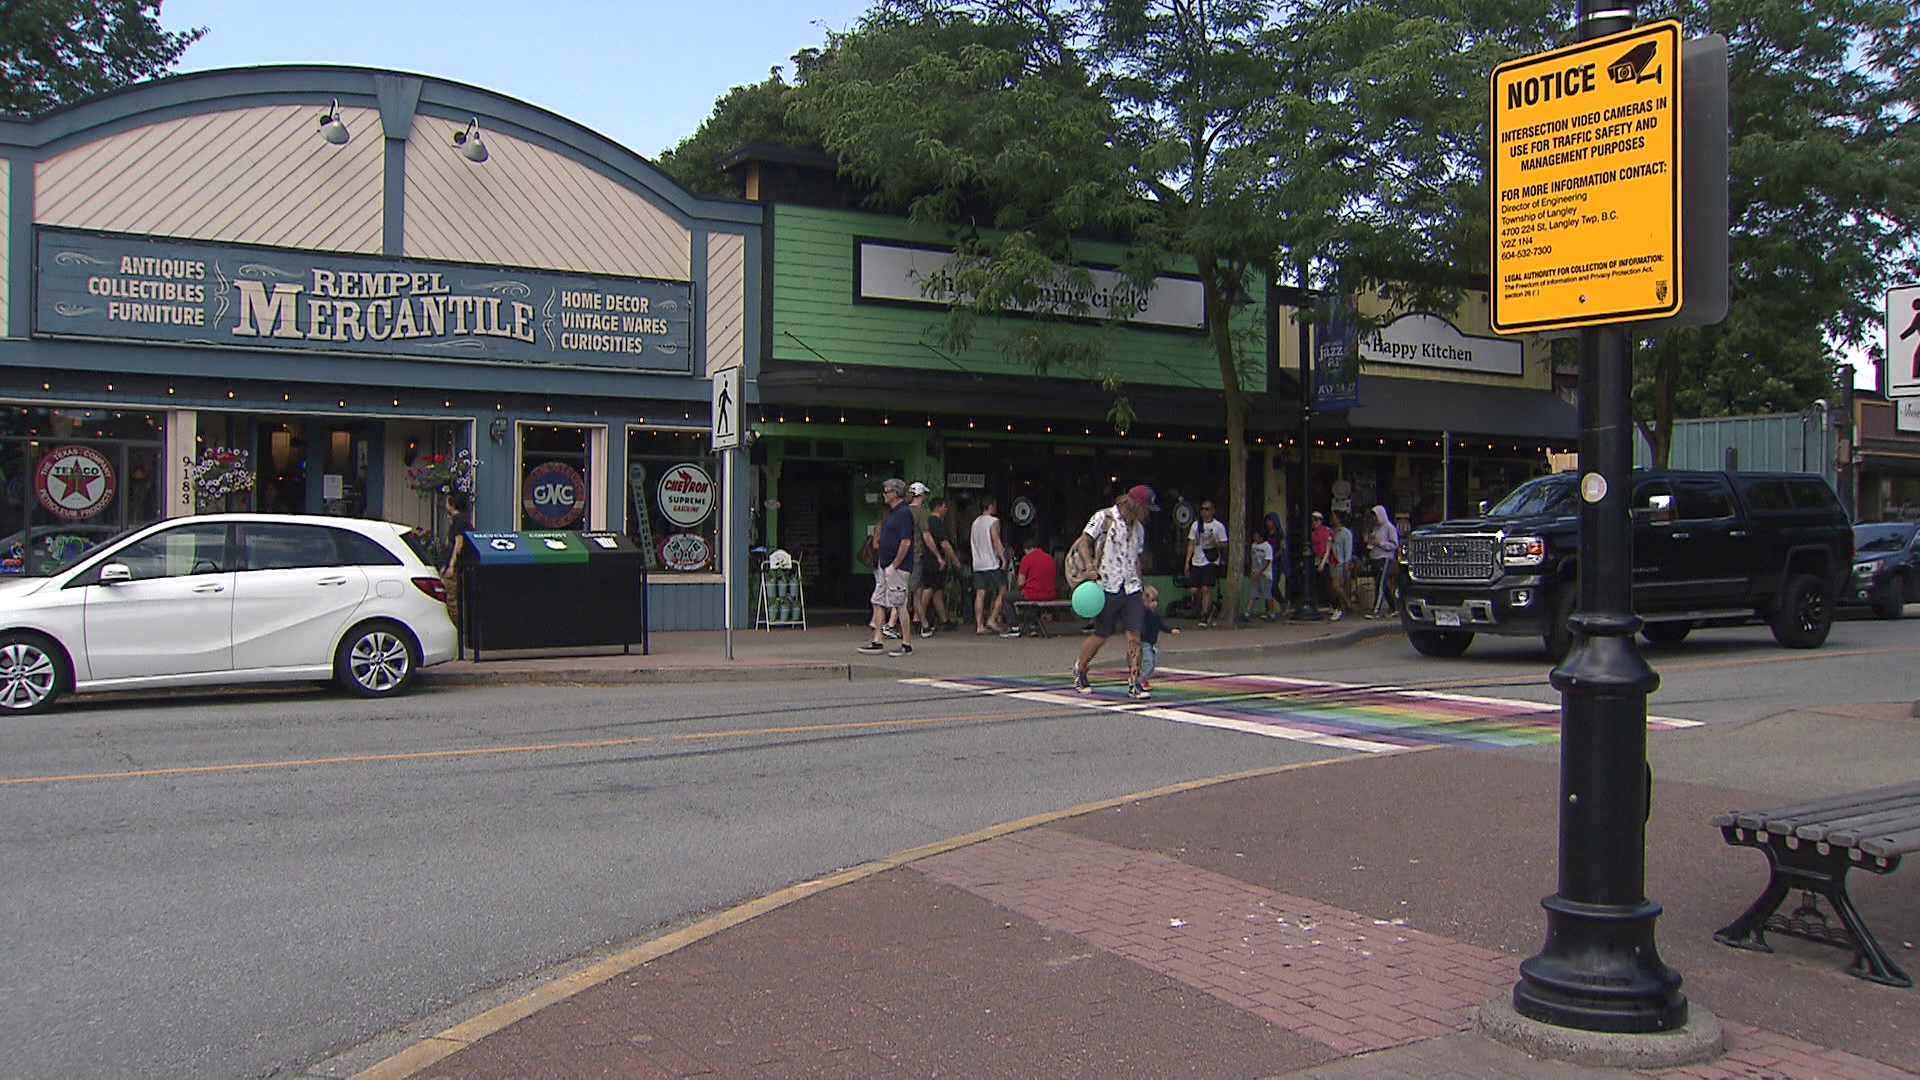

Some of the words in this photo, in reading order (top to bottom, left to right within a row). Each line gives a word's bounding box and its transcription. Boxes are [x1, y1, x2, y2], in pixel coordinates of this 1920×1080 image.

[1507, 63, 1596, 110] NOTICE
[1501, 118, 1568, 144] INTERSECTION
[1571, 111, 1601, 128] VIDEO
[1603, 99, 1653, 122] CAMERAS
[1656, 96, 1667, 110] IN
[1510, 143, 1529, 158] USE
[1531, 139, 1550, 153] FOR
[1553, 130, 1592, 149] TRAFFIC
[1595, 121, 1632, 140] SAFETY
[1635, 116, 1658, 131] AND
[1520, 147, 1589, 172] MANAGEMENT
[1591, 136, 1645, 158] PURPOSES
[1501, 188, 1520, 202] FOR
[1522, 183, 1549, 199] MORE
[1551, 171, 1617, 195] INFORMATION
[1619, 161, 1667, 181] CONTACT:
[1501, 202, 1531, 213] Director
[1532, 199, 1540, 209] of
[1541, 192, 1588, 207] Engineering
[1501, 212, 1536, 226] Township
[1537, 210, 1545, 219] of
[1546, 206, 1577, 218] Langley
[1501, 227, 1520, 237] 4700
[1521, 224, 1535, 235] 224
[1549, 217, 1580, 230] Langley
[1601, 210, 1619, 221] B.C.
[1501, 238, 1516, 248] V2Z
[1518, 236, 1533, 246] 1N4
[1501, 245, 1552, 261] 604-532-7300
[120, 256, 206, 280] ANTIQUES
[1504, 272, 1522, 283] LEGAL
[1523, 269, 1556, 281] AUTHORITY
[1557, 266, 1570, 277] FOR
[1571, 261, 1608, 274] COLLECTION
[1609, 259, 1617, 269] OF
[1618, 254, 1664, 267] INFORMATION:
[1504, 283, 1515, 291] The
[1515, 280, 1540, 290] Freedom
[1540, 279, 1546, 287] of
[1546, 276, 1577, 287] Information
[1590, 271, 1611, 281] Privacy
[1612, 267, 1641, 278] Protection
[88, 276, 205, 303] COLLECTIBLES
[311, 268, 450, 298] REMPEL
[108, 302, 205, 326] FURNITURE
[232, 279, 535, 344] MERCANTILE
[561, 290, 602, 310] HOME
[605, 294, 649, 314] DECOR
[561, 311, 619, 331] VINTAGE
[622, 316, 668, 335] WARES
[561, 332, 643, 354] CURIOSITIES
[1373, 335, 1418, 359] Happy
[1422, 342, 1473, 362] Kitchen
[53, 448, 79, 461] TEXAS
[83, 449, 113, 478] COMPANY
[54, 466, 99, 475] TEXACO
[533, 483, 574, 505] GMC
[664, 469, 709, 494] CHEVRON
[39, 488, 78, 517] PETROLEUM
[80, 488, 113, 517] PRODUCTS
[668, 496, 707, 505] SUPREME
